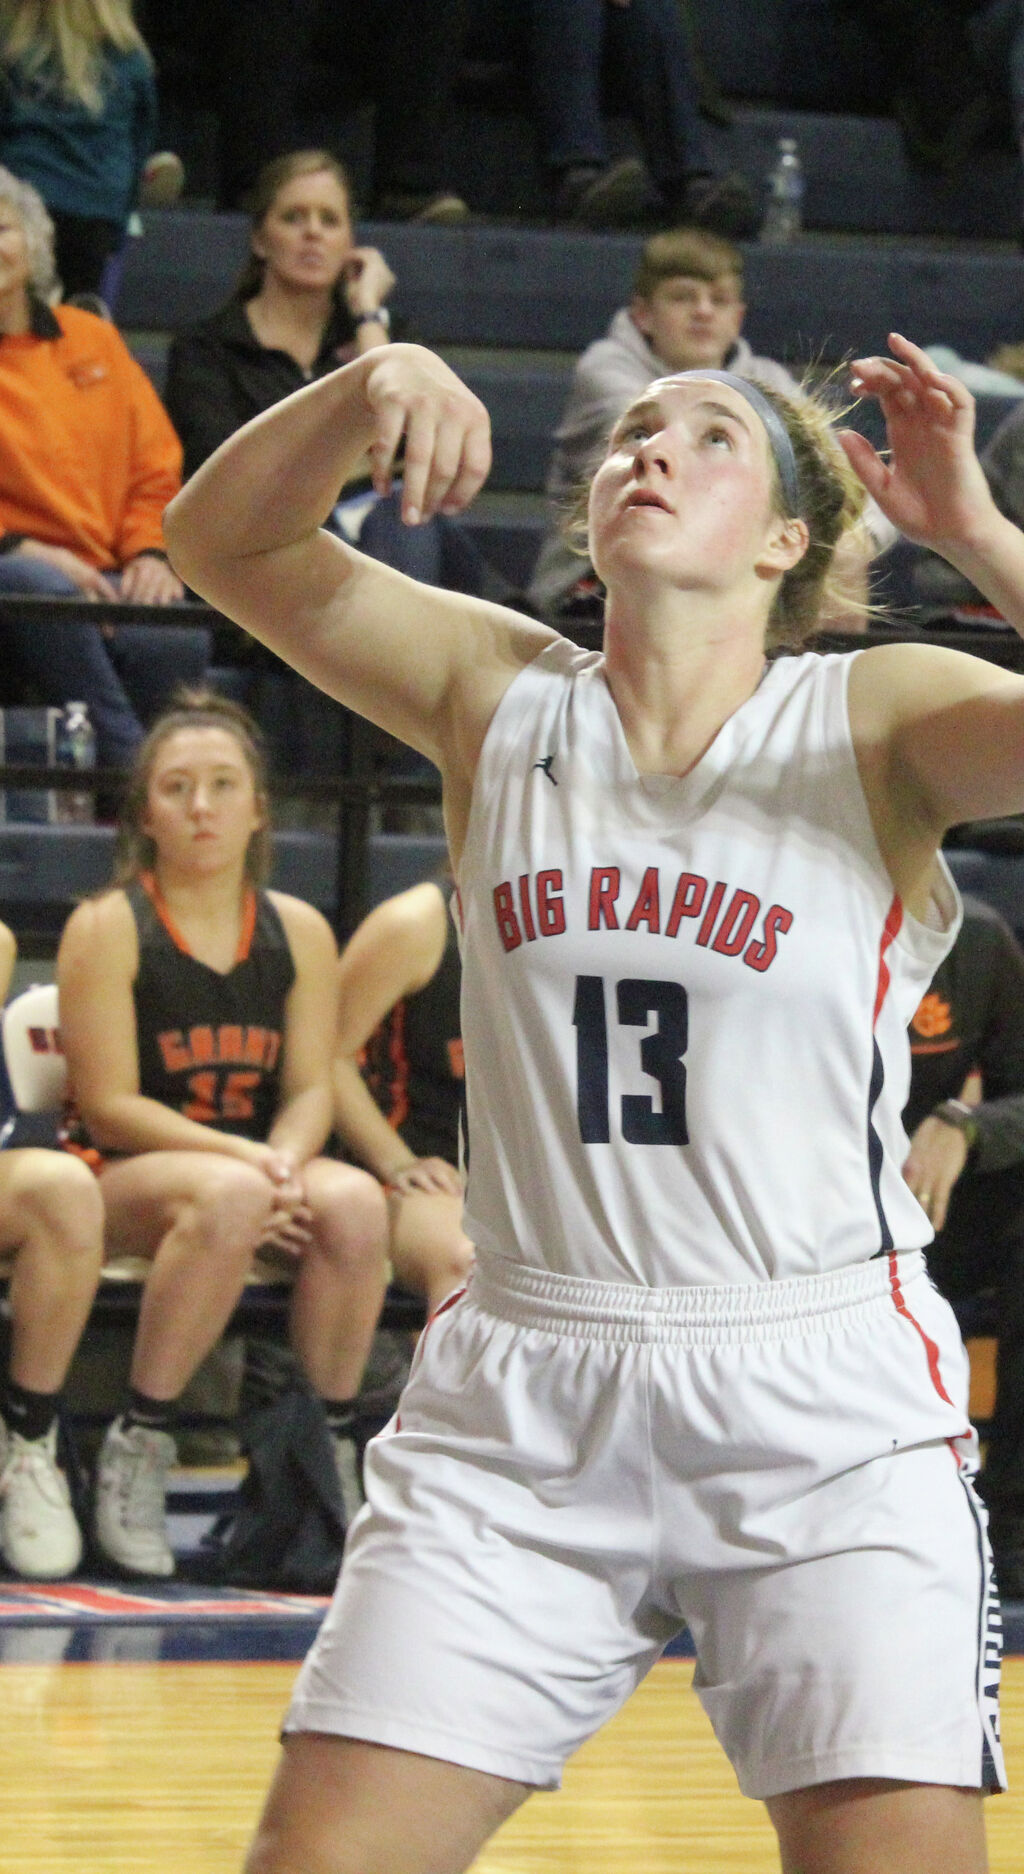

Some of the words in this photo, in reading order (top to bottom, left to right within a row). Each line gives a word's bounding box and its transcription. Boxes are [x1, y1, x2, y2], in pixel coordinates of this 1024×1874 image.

[493, 868, 567, 953] BIG
[587, 866, 794, 973] RAPIDS
[572, 974, 690, 1145] 13
